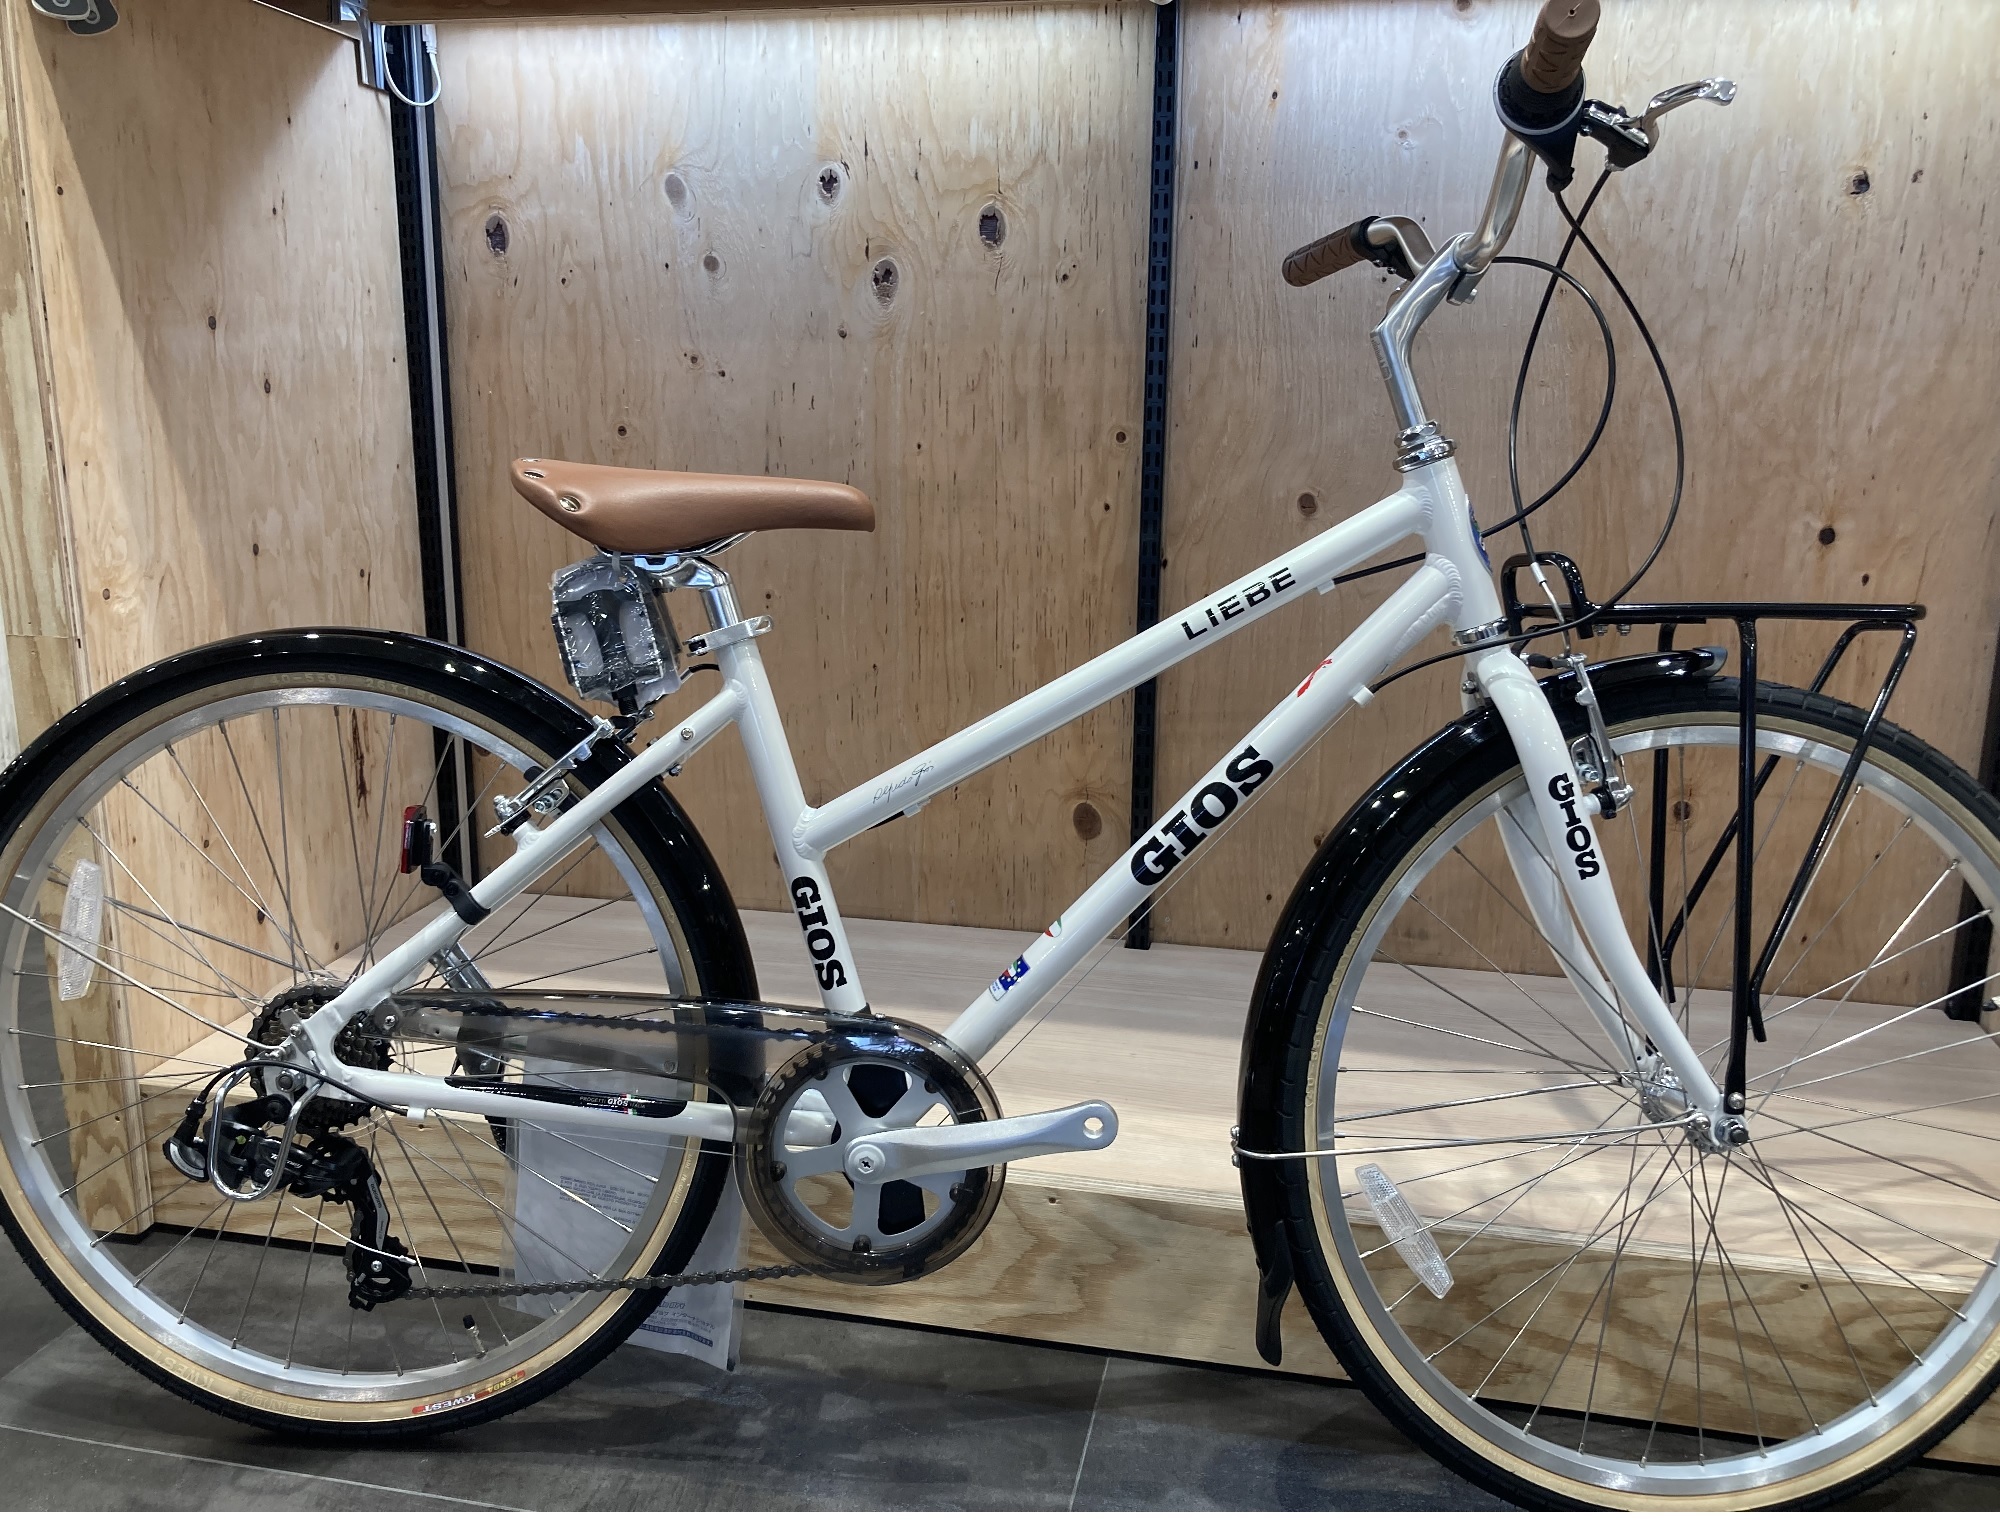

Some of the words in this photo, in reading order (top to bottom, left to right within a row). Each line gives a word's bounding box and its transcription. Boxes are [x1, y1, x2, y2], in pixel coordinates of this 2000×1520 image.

[1181, 567, 1296, 640] LIEBE
[1130, 744, 1274, 886] GIOS
[1548, 772, 1600, 880] GIOS
[791, 876, 847, 991] GIOS
[422, 1392, 476, 1413] KWEST
[487, 1373, 519, 1393] KENDA
